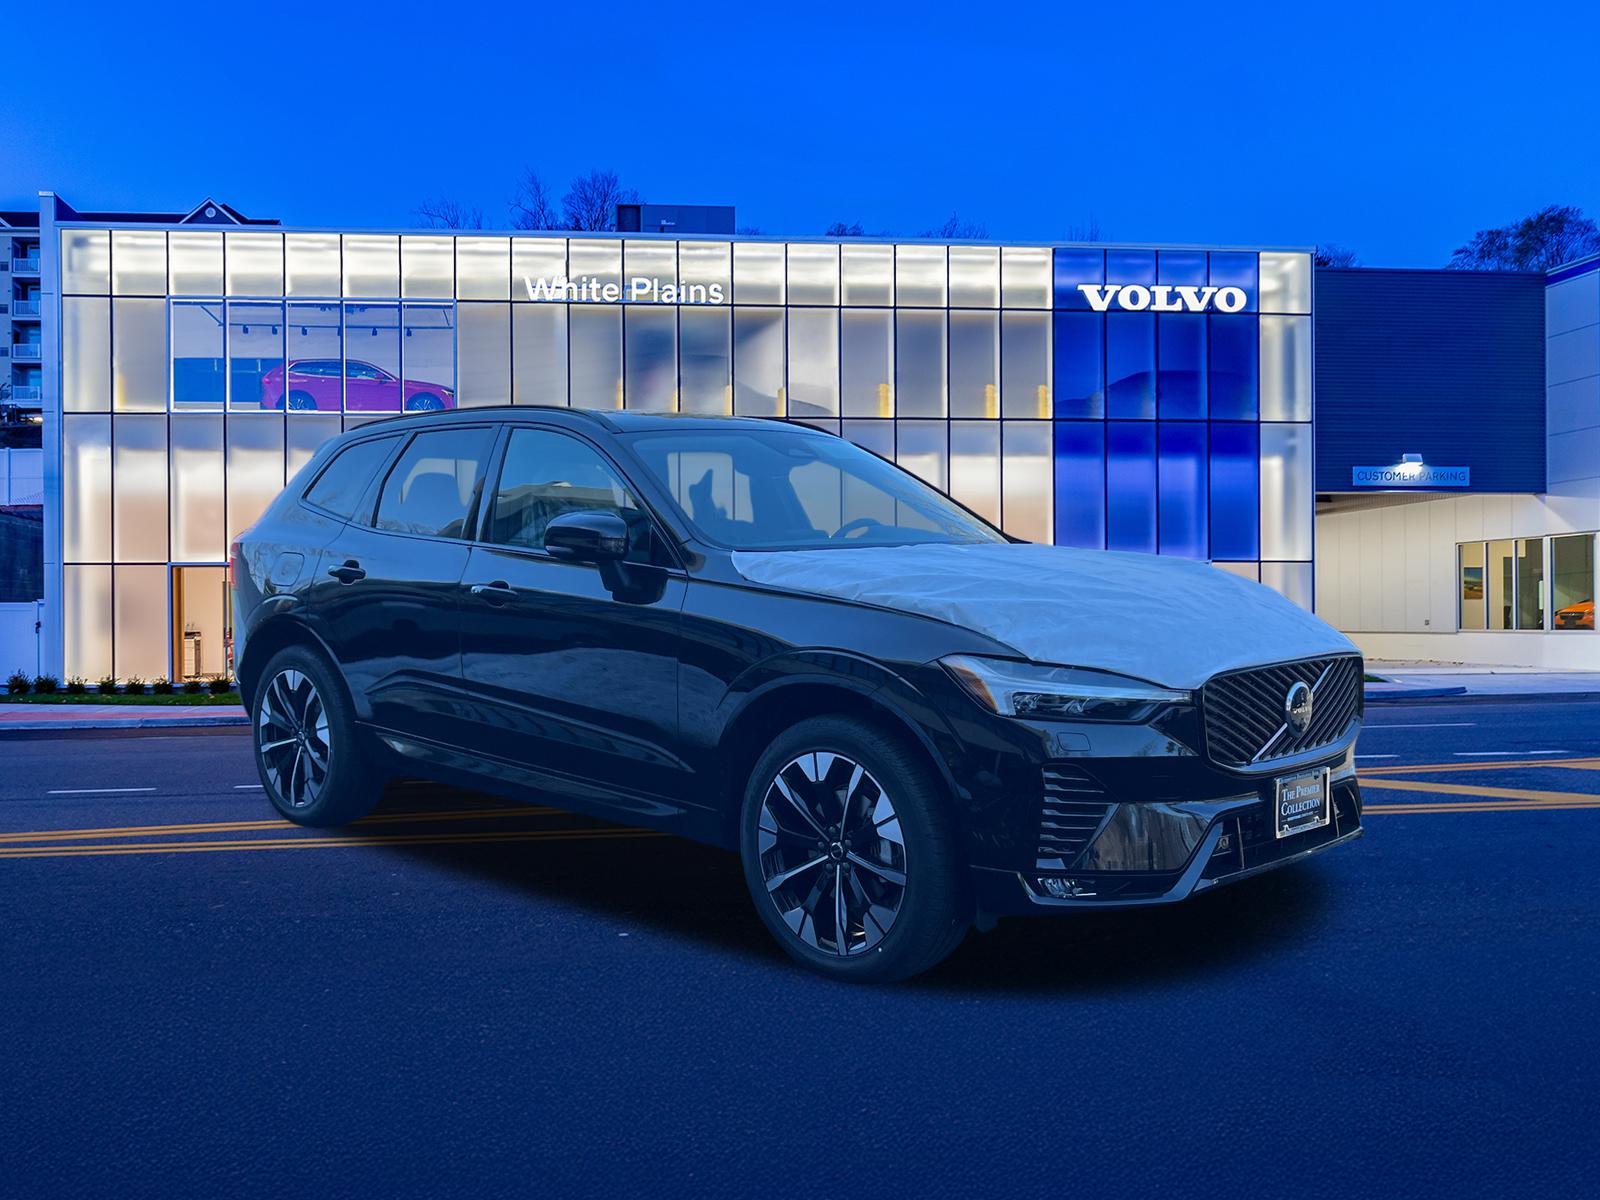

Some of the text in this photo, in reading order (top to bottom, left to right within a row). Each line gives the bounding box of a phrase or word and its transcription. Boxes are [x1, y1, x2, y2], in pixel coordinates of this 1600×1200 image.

[524, 275, 725, 304] White Plains
[1077, 284, 1247, 313] VOLVO
[1357, 471, 1466, 481] CUSTOMER PARKING
[1281, 788, 1295, 801] THE
[1281, 798, 1320, 816] COLLECTION
